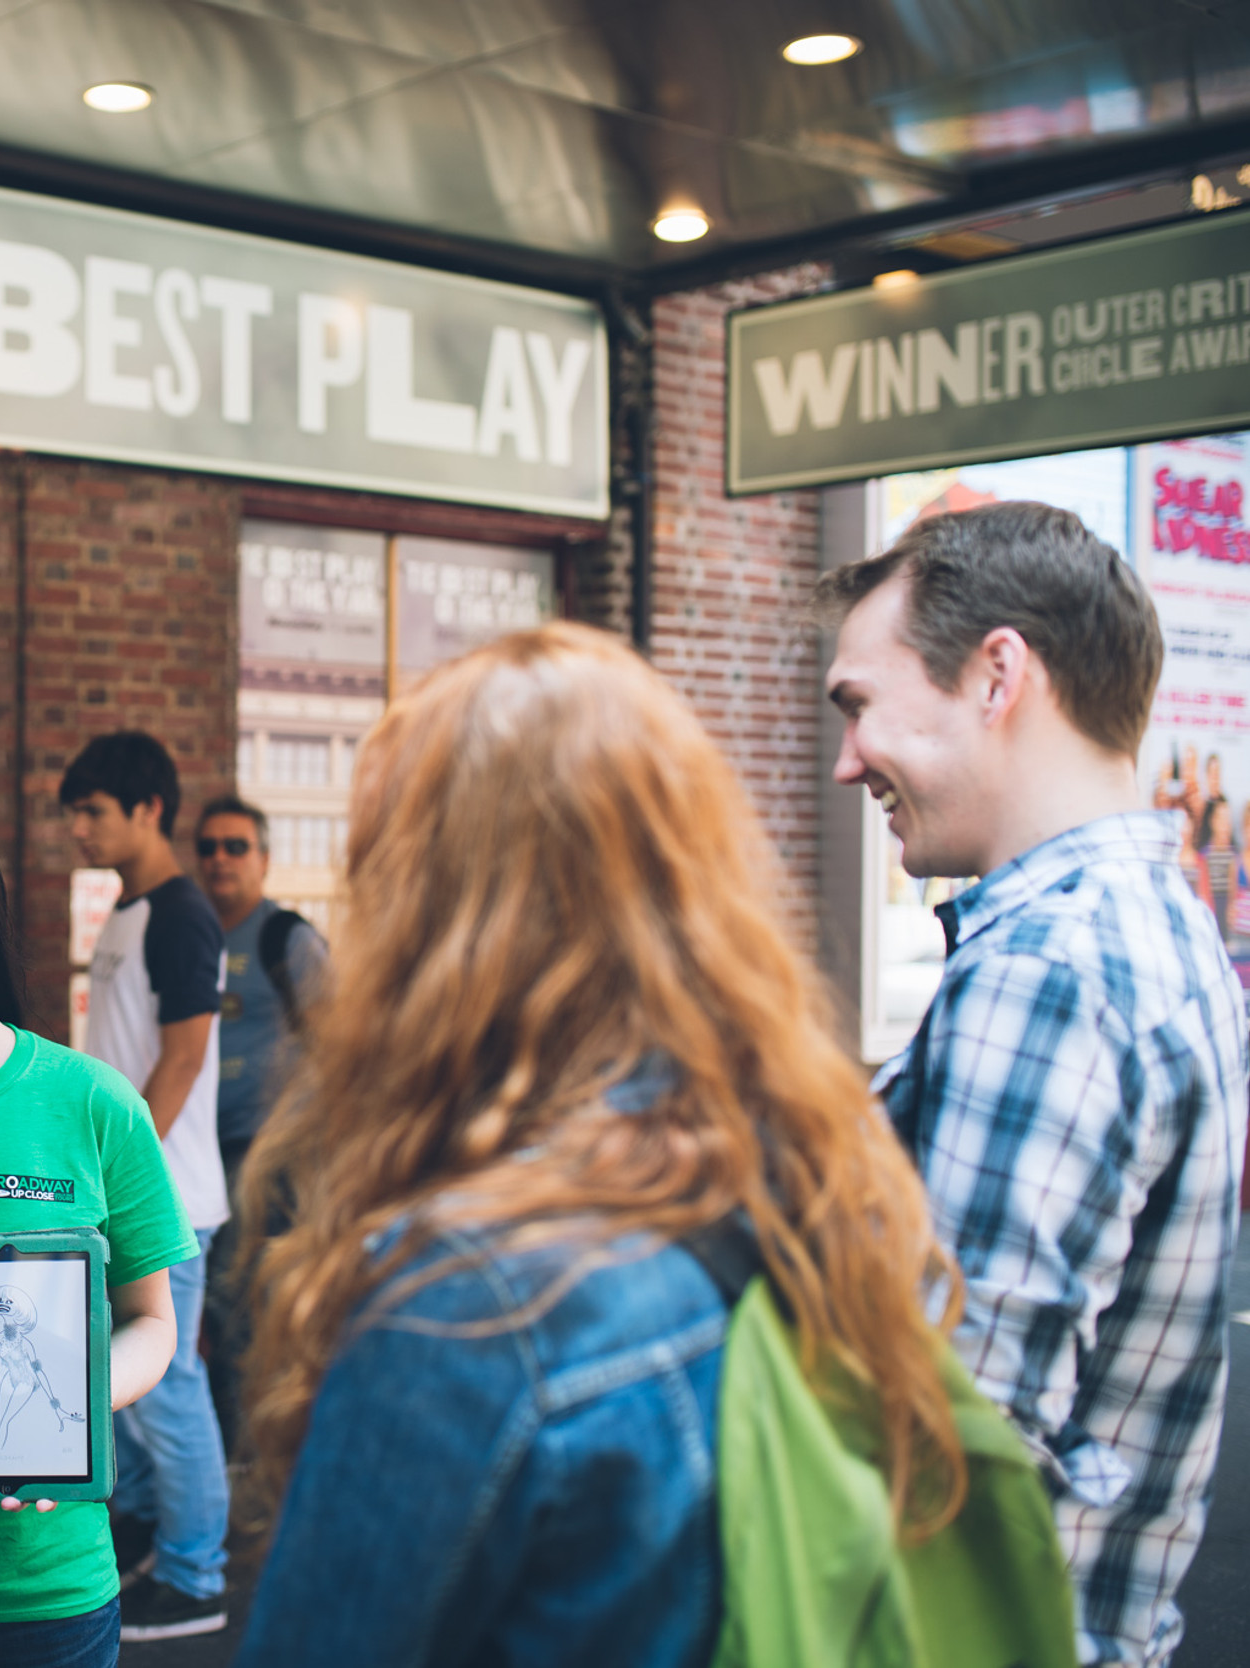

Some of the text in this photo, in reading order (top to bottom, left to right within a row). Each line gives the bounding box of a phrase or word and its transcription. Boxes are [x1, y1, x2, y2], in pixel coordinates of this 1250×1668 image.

[1052, 286, 1165, 348] OUTER
[297, 292, 590, 467] PLAY
[754, 310, 1044, 437] WINNER
[1052, 334, 1165, 394] CIRCLE
[11, 1188, 55, 1201] UP CLOSE
